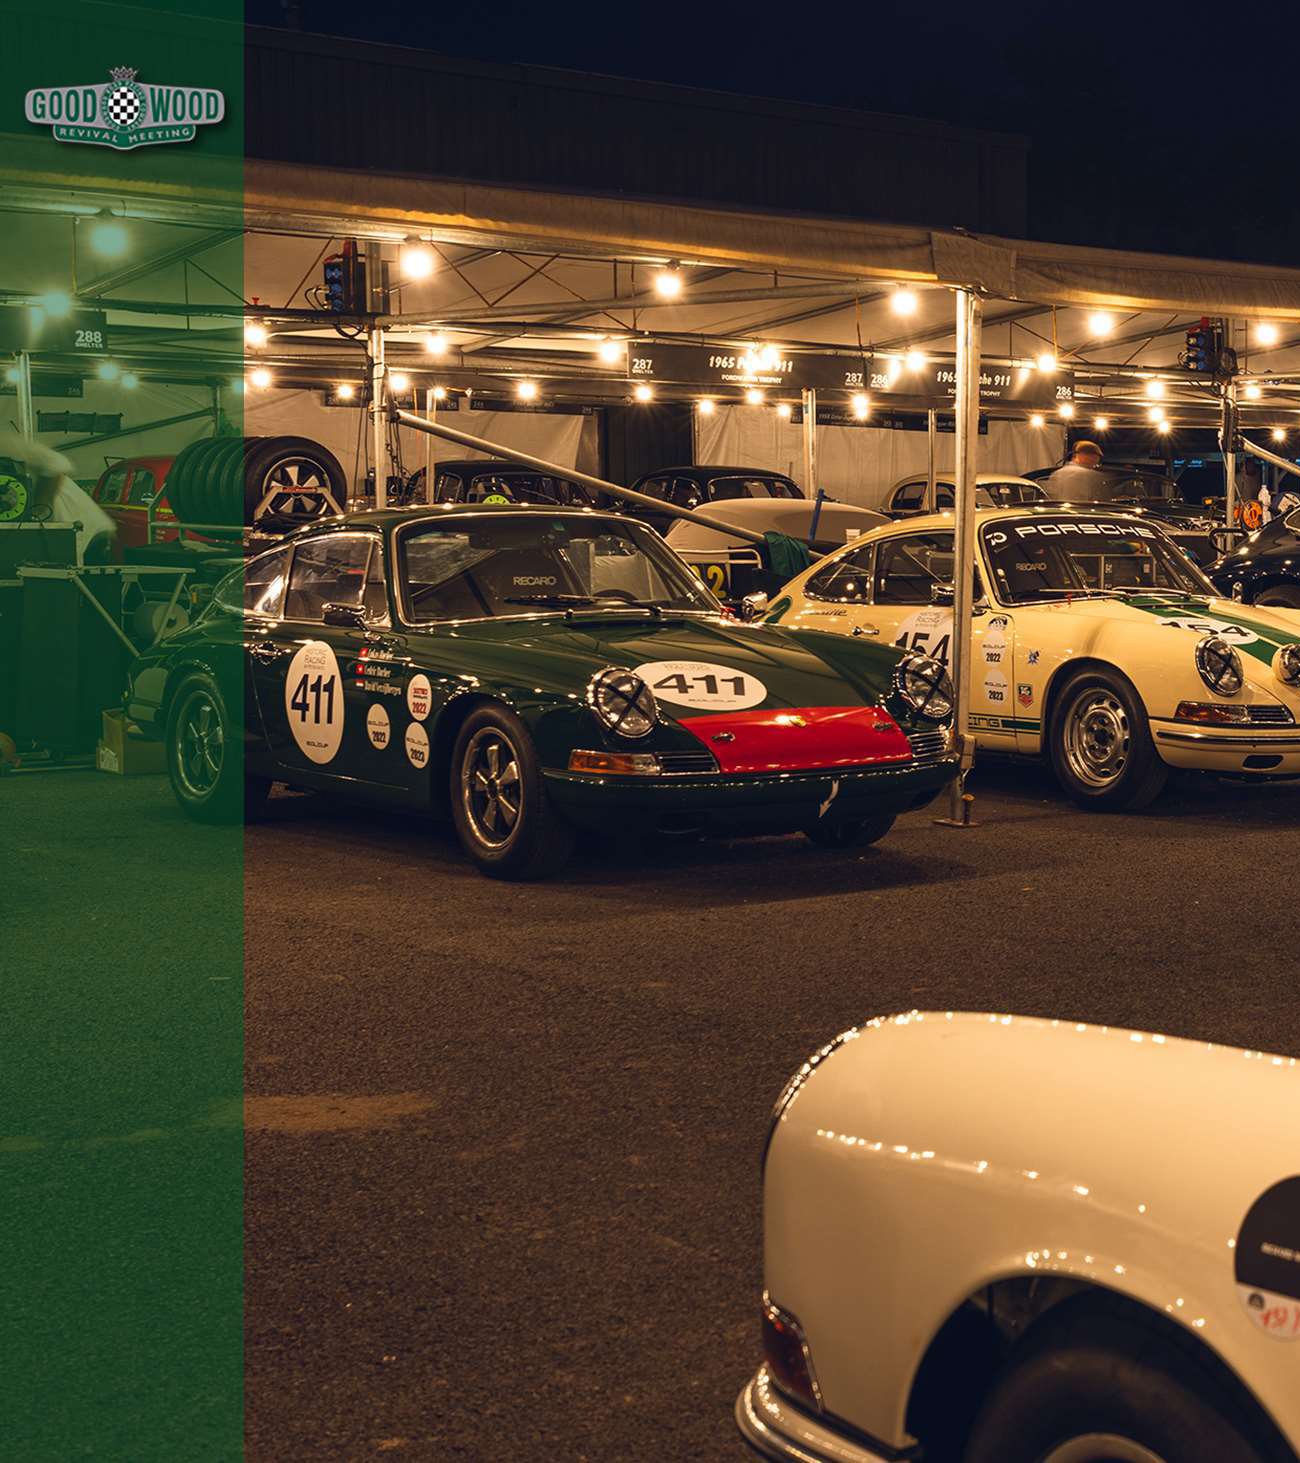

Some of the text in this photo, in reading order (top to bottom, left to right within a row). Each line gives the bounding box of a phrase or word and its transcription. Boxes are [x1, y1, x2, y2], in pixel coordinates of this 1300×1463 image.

[75, 330, 102, 343] 288
[632, 358, 653, 370] 287
[708, 356, 735, 369] 1965
[845, 372, 863, 382] 287
[871, 373, 888, 385] 286
[994, 375, 1011, 386] 911
[1056, 386, 1072, 396] 286
[1014, 523, 1157, 539] PORSCHE
[513, 576, 557, 586] RECARO
[986, 652, 1001, 663] 2022
[653, 673, 746, 696] 411
[291, 673, 336, 725] 411
